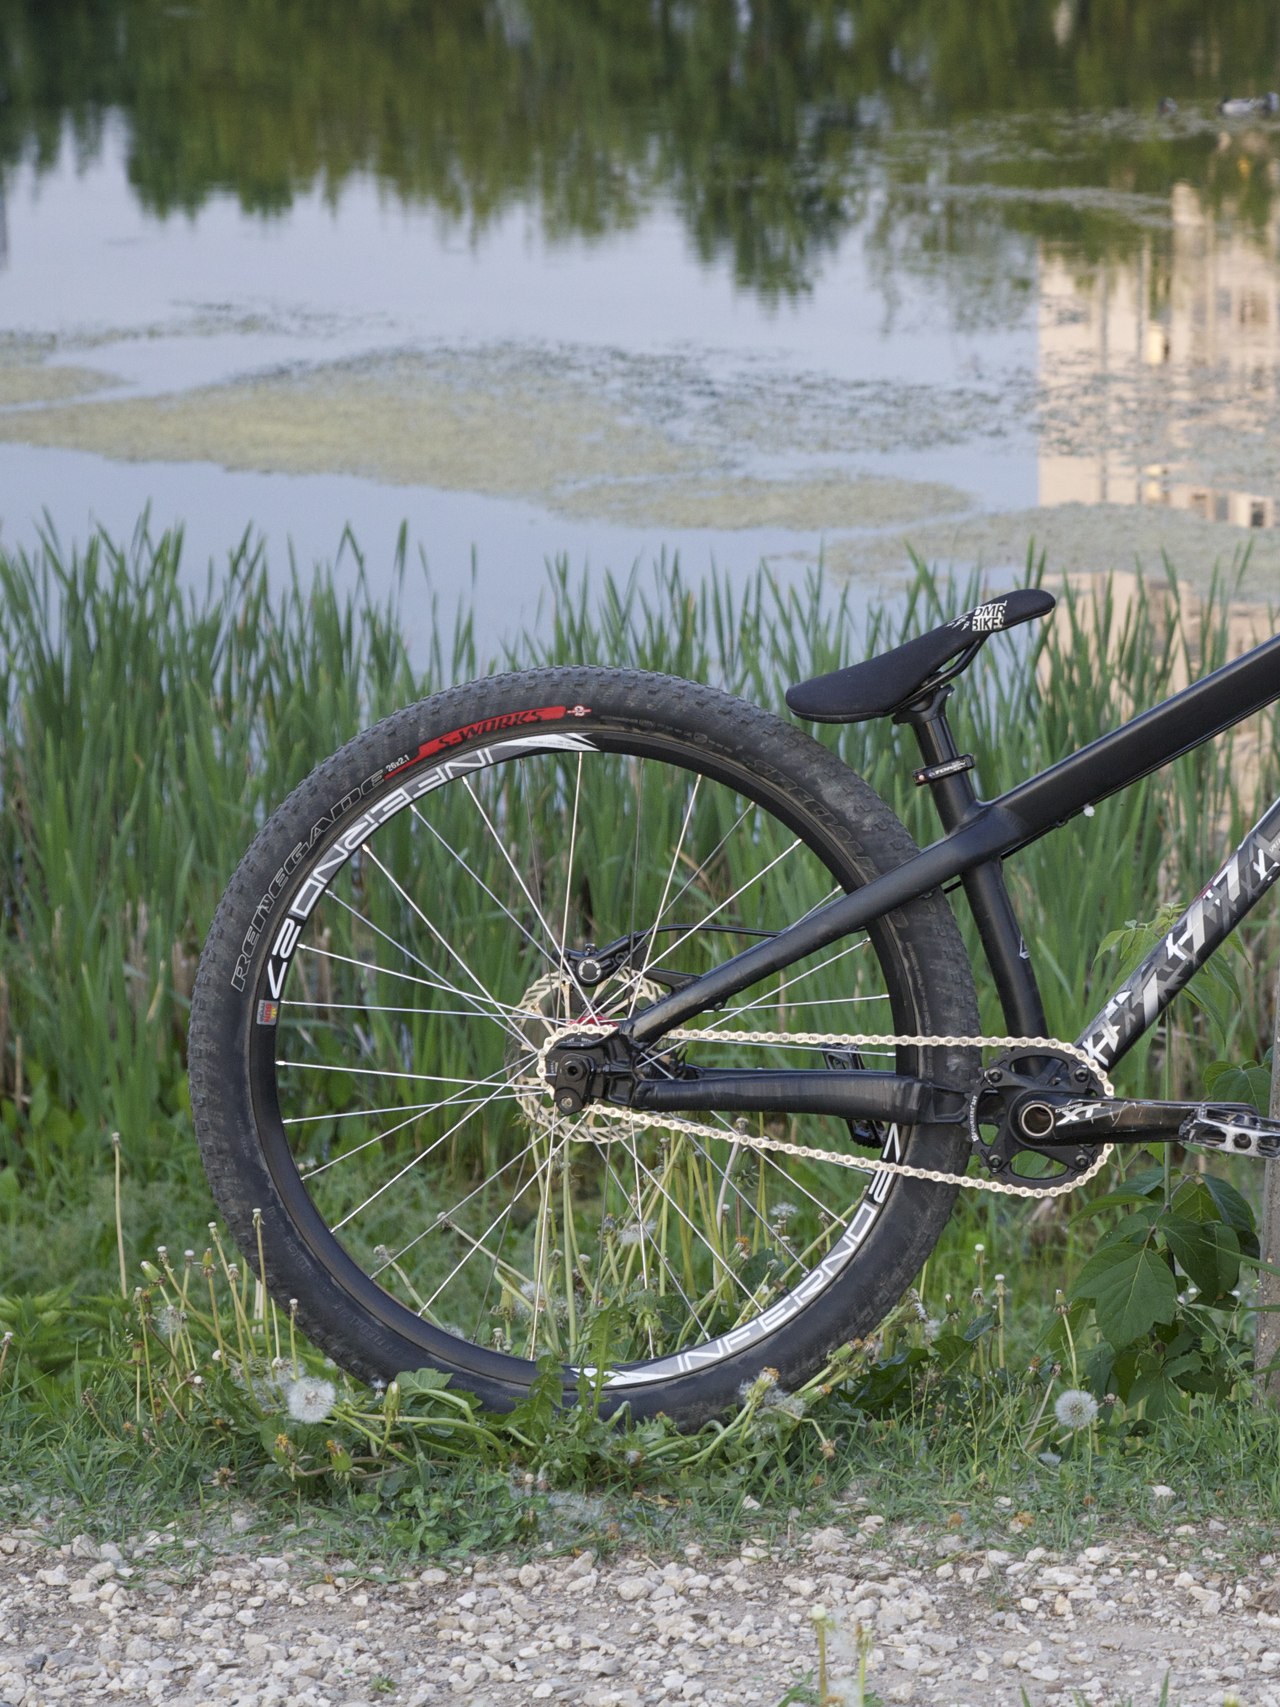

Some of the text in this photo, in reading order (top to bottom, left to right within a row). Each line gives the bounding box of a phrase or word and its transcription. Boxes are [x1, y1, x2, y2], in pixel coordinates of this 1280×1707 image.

[973, 603, 1005, 617] DMR
[438, 708, 546, 748] S-WORKS
[230, 754, 410, 992] RENEGADE 26x2.1
[267, 747, 494, 1000] INFERNO 27
[1055, 1102, 1102, 1126] XT
[677, 1201, 879, 1373] INFERNO
